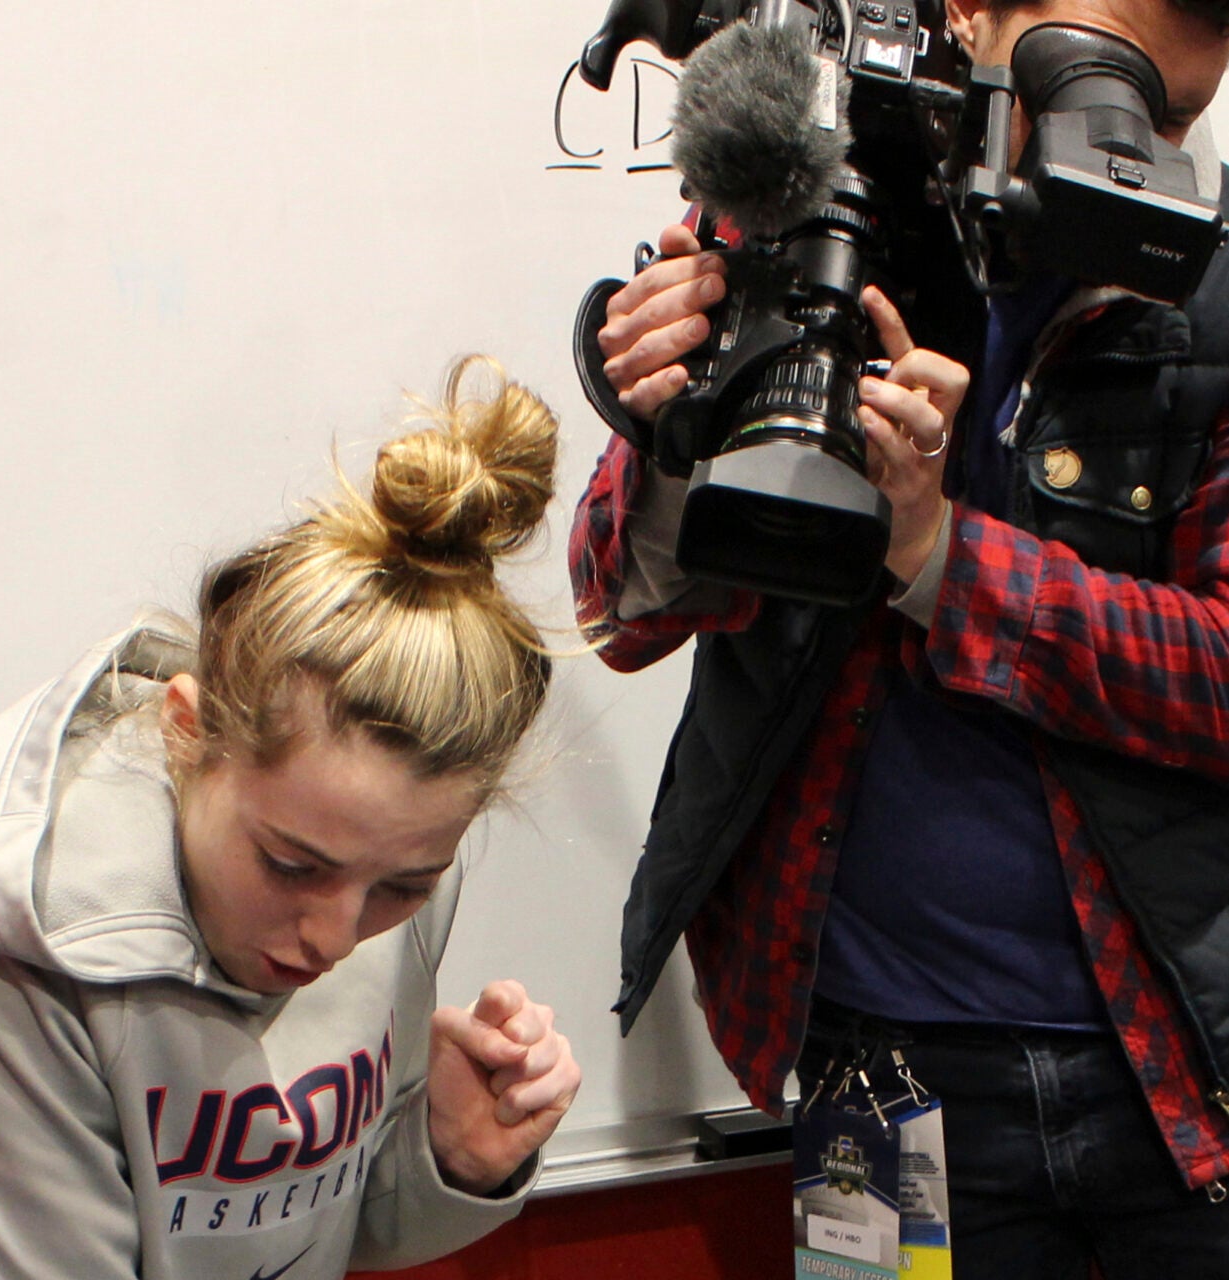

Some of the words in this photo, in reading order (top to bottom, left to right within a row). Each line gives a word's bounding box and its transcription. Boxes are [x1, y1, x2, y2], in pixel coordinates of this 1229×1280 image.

[1139, 243, 1186, 262] SONY
[825, 1158, 867, 1176] REGIONAL
[169, 1145, 364, 1233] ASKETBA
[845, 1233, 862, 1244] HBO
